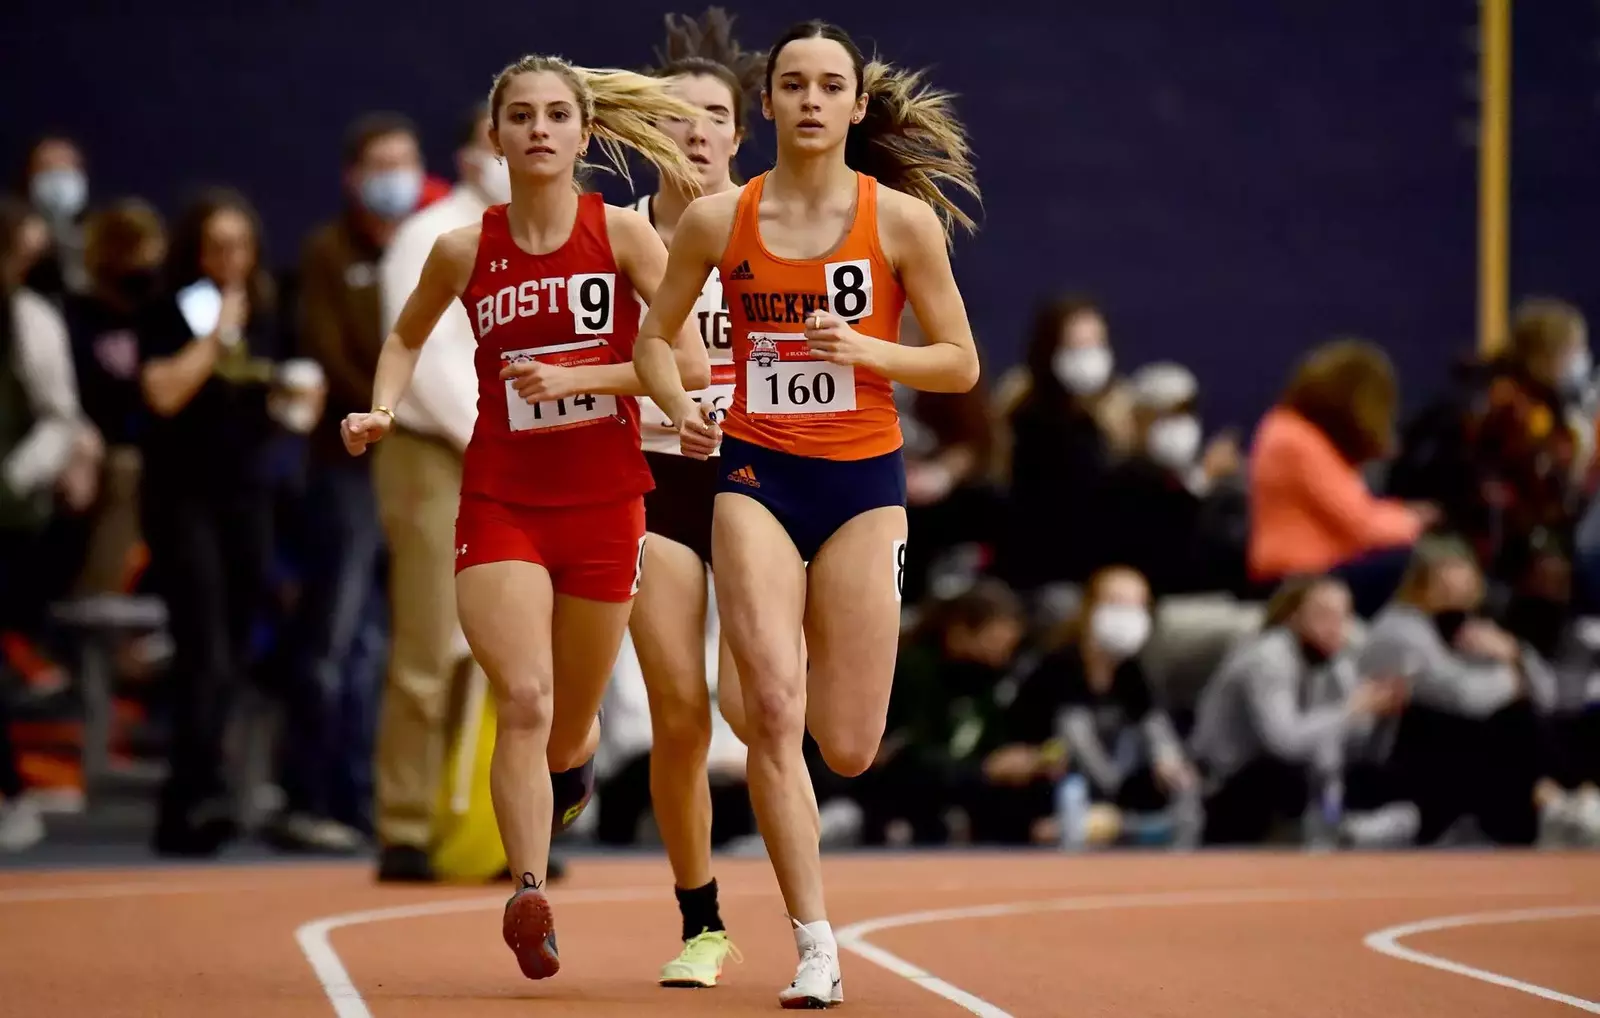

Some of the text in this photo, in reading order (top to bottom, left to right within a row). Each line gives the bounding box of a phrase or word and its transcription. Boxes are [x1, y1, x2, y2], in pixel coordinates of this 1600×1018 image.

[476, 277, 575, 338] BOST
[580, 277, 610, 330] 9
[833, 265, 867, 317] 8
[765, 372, 835, 405] 160
[727, 473, 761, 489] adidas
